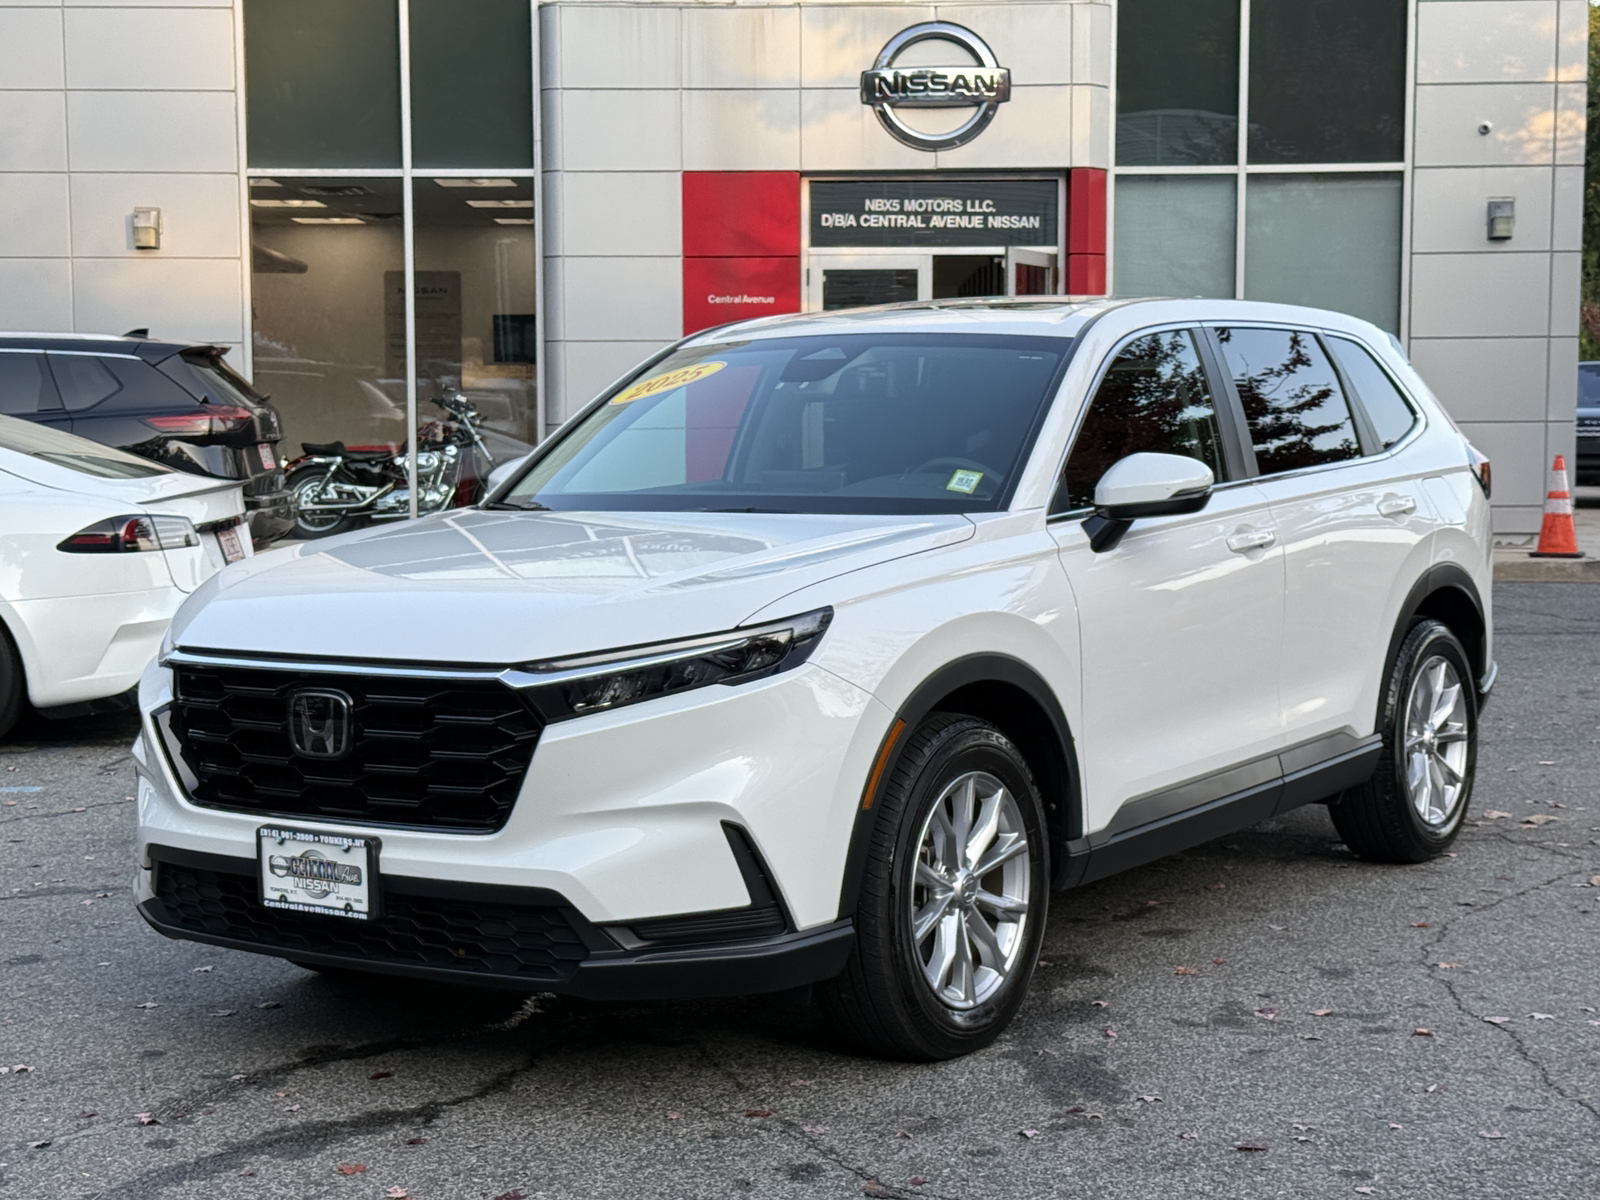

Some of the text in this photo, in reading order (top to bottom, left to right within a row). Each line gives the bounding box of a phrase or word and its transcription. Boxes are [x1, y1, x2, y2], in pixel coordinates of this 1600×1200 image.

[874, 73, 997, 97] NISSAN
[865, 199, 996, 213] NBX5 MOTORS LLC.
[821, 214, 1040, 228] D/B/A CENTRAL AVENUE NISSAN
[707, 294, 775, 304] Central Avenue
[624, 363, 712, 401] 2025
[290, 856, 340, 881] CENTRAL
[293, 877, 340, 895] NISSAN
[264, 900, 368, 919] CentralAveNissan.com
